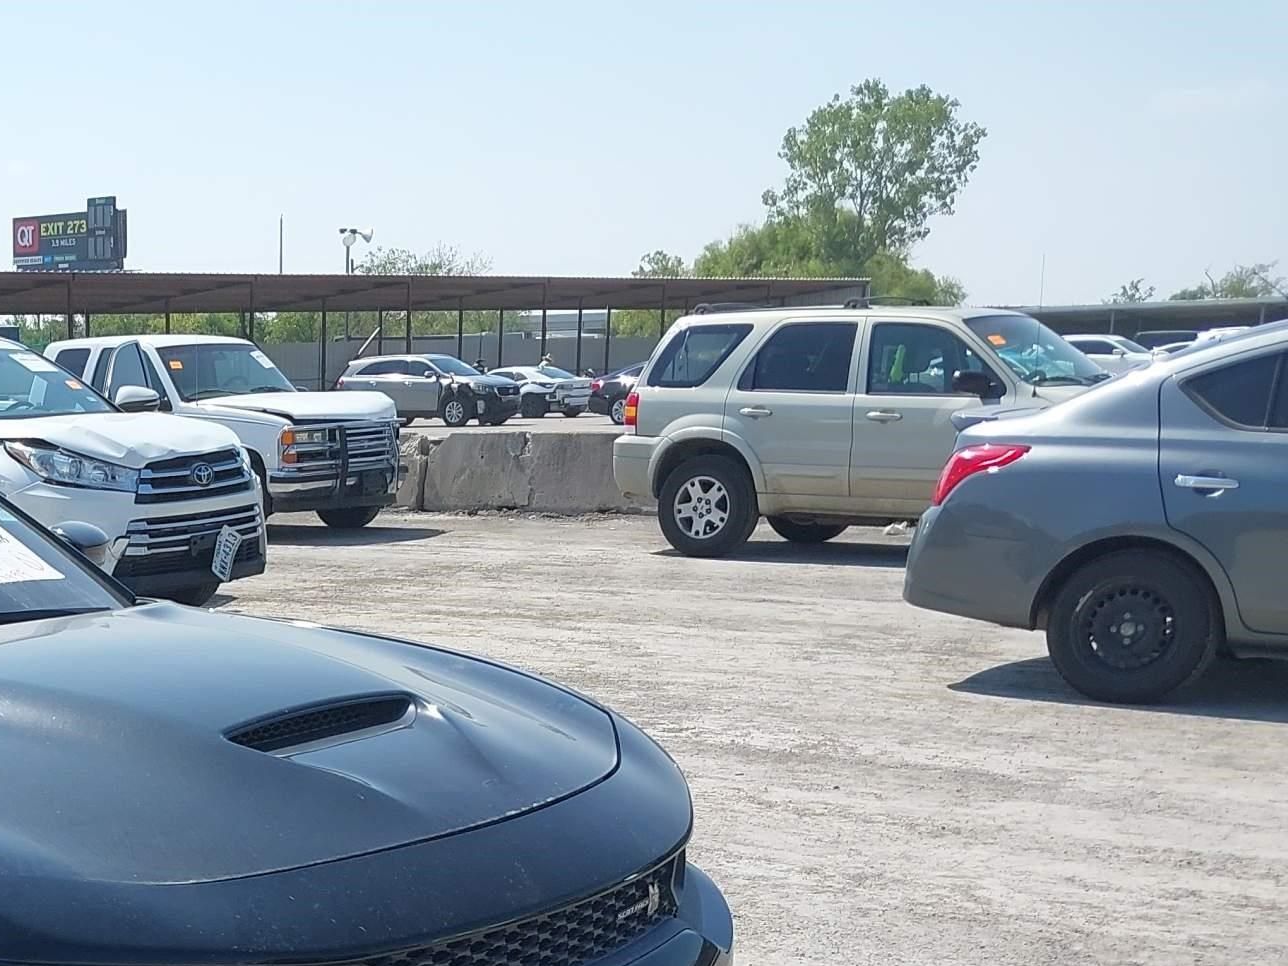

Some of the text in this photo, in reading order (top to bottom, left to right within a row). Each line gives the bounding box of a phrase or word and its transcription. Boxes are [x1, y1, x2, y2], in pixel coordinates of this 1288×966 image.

[17, 226, 35, 247] QT
[40, 220, 87, 236] EXIT 273
